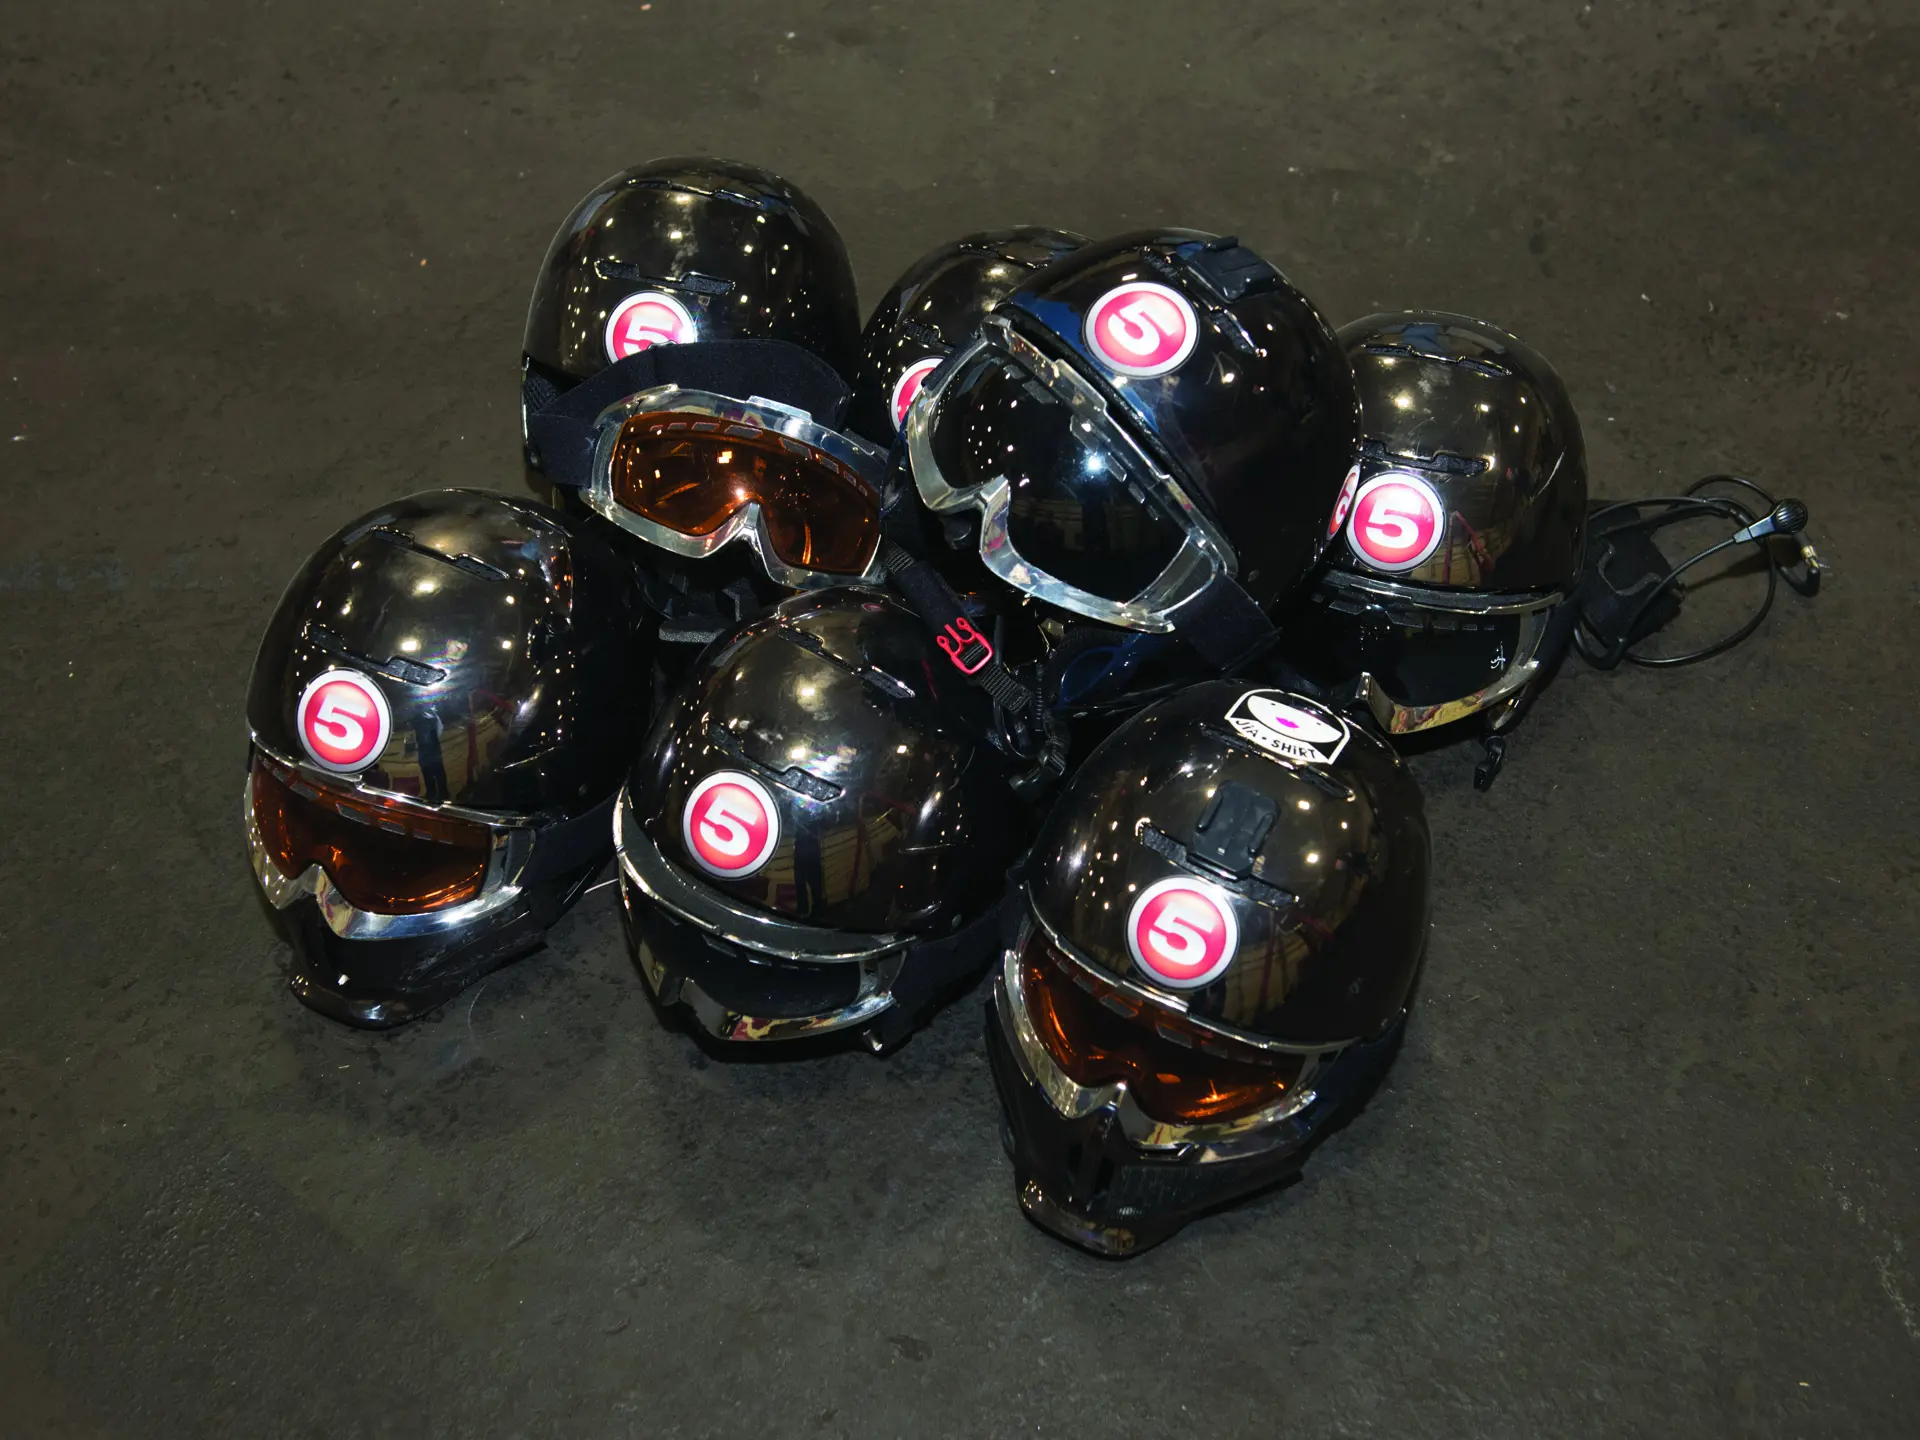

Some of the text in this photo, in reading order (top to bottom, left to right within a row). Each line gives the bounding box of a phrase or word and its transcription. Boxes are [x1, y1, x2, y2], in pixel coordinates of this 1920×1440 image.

[1107, 299, 1177, 355] 5
[1365, 498, 1421, 549] 5
[314, 693, 368, 750] 5
[700, 794, 758, 856] 5
[1149, 901, 1216, 966] 5
